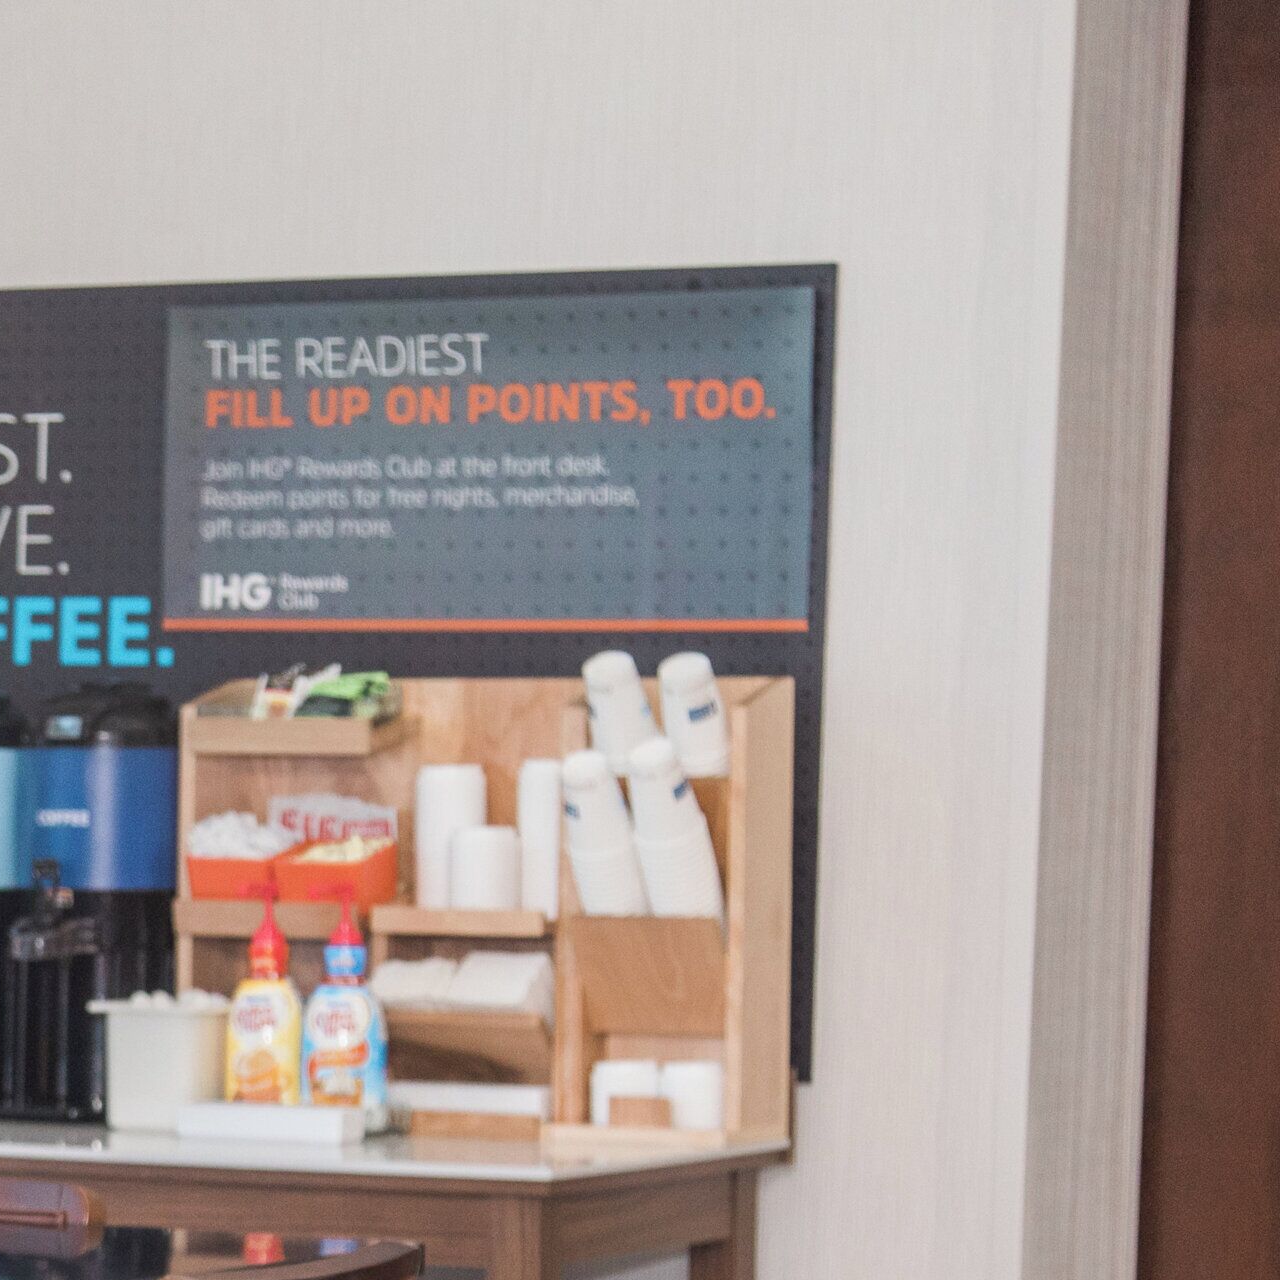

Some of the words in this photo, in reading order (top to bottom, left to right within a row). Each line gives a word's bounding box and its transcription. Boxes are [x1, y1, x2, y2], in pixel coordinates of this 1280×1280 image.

[204, 338, 282, 380] THE
[294, 333, 490, 379] READIEST
[205, 388, 295, 428] FILL
[308, 386, 371, 427] UP
[384, 384, 451, 426] ON
[466, 379, 652, 426] POINTS,
[666, 377, 777, 421] TOO.
[385, 454, 432, 480] Club
[200, 572, 272, 611] IHG
